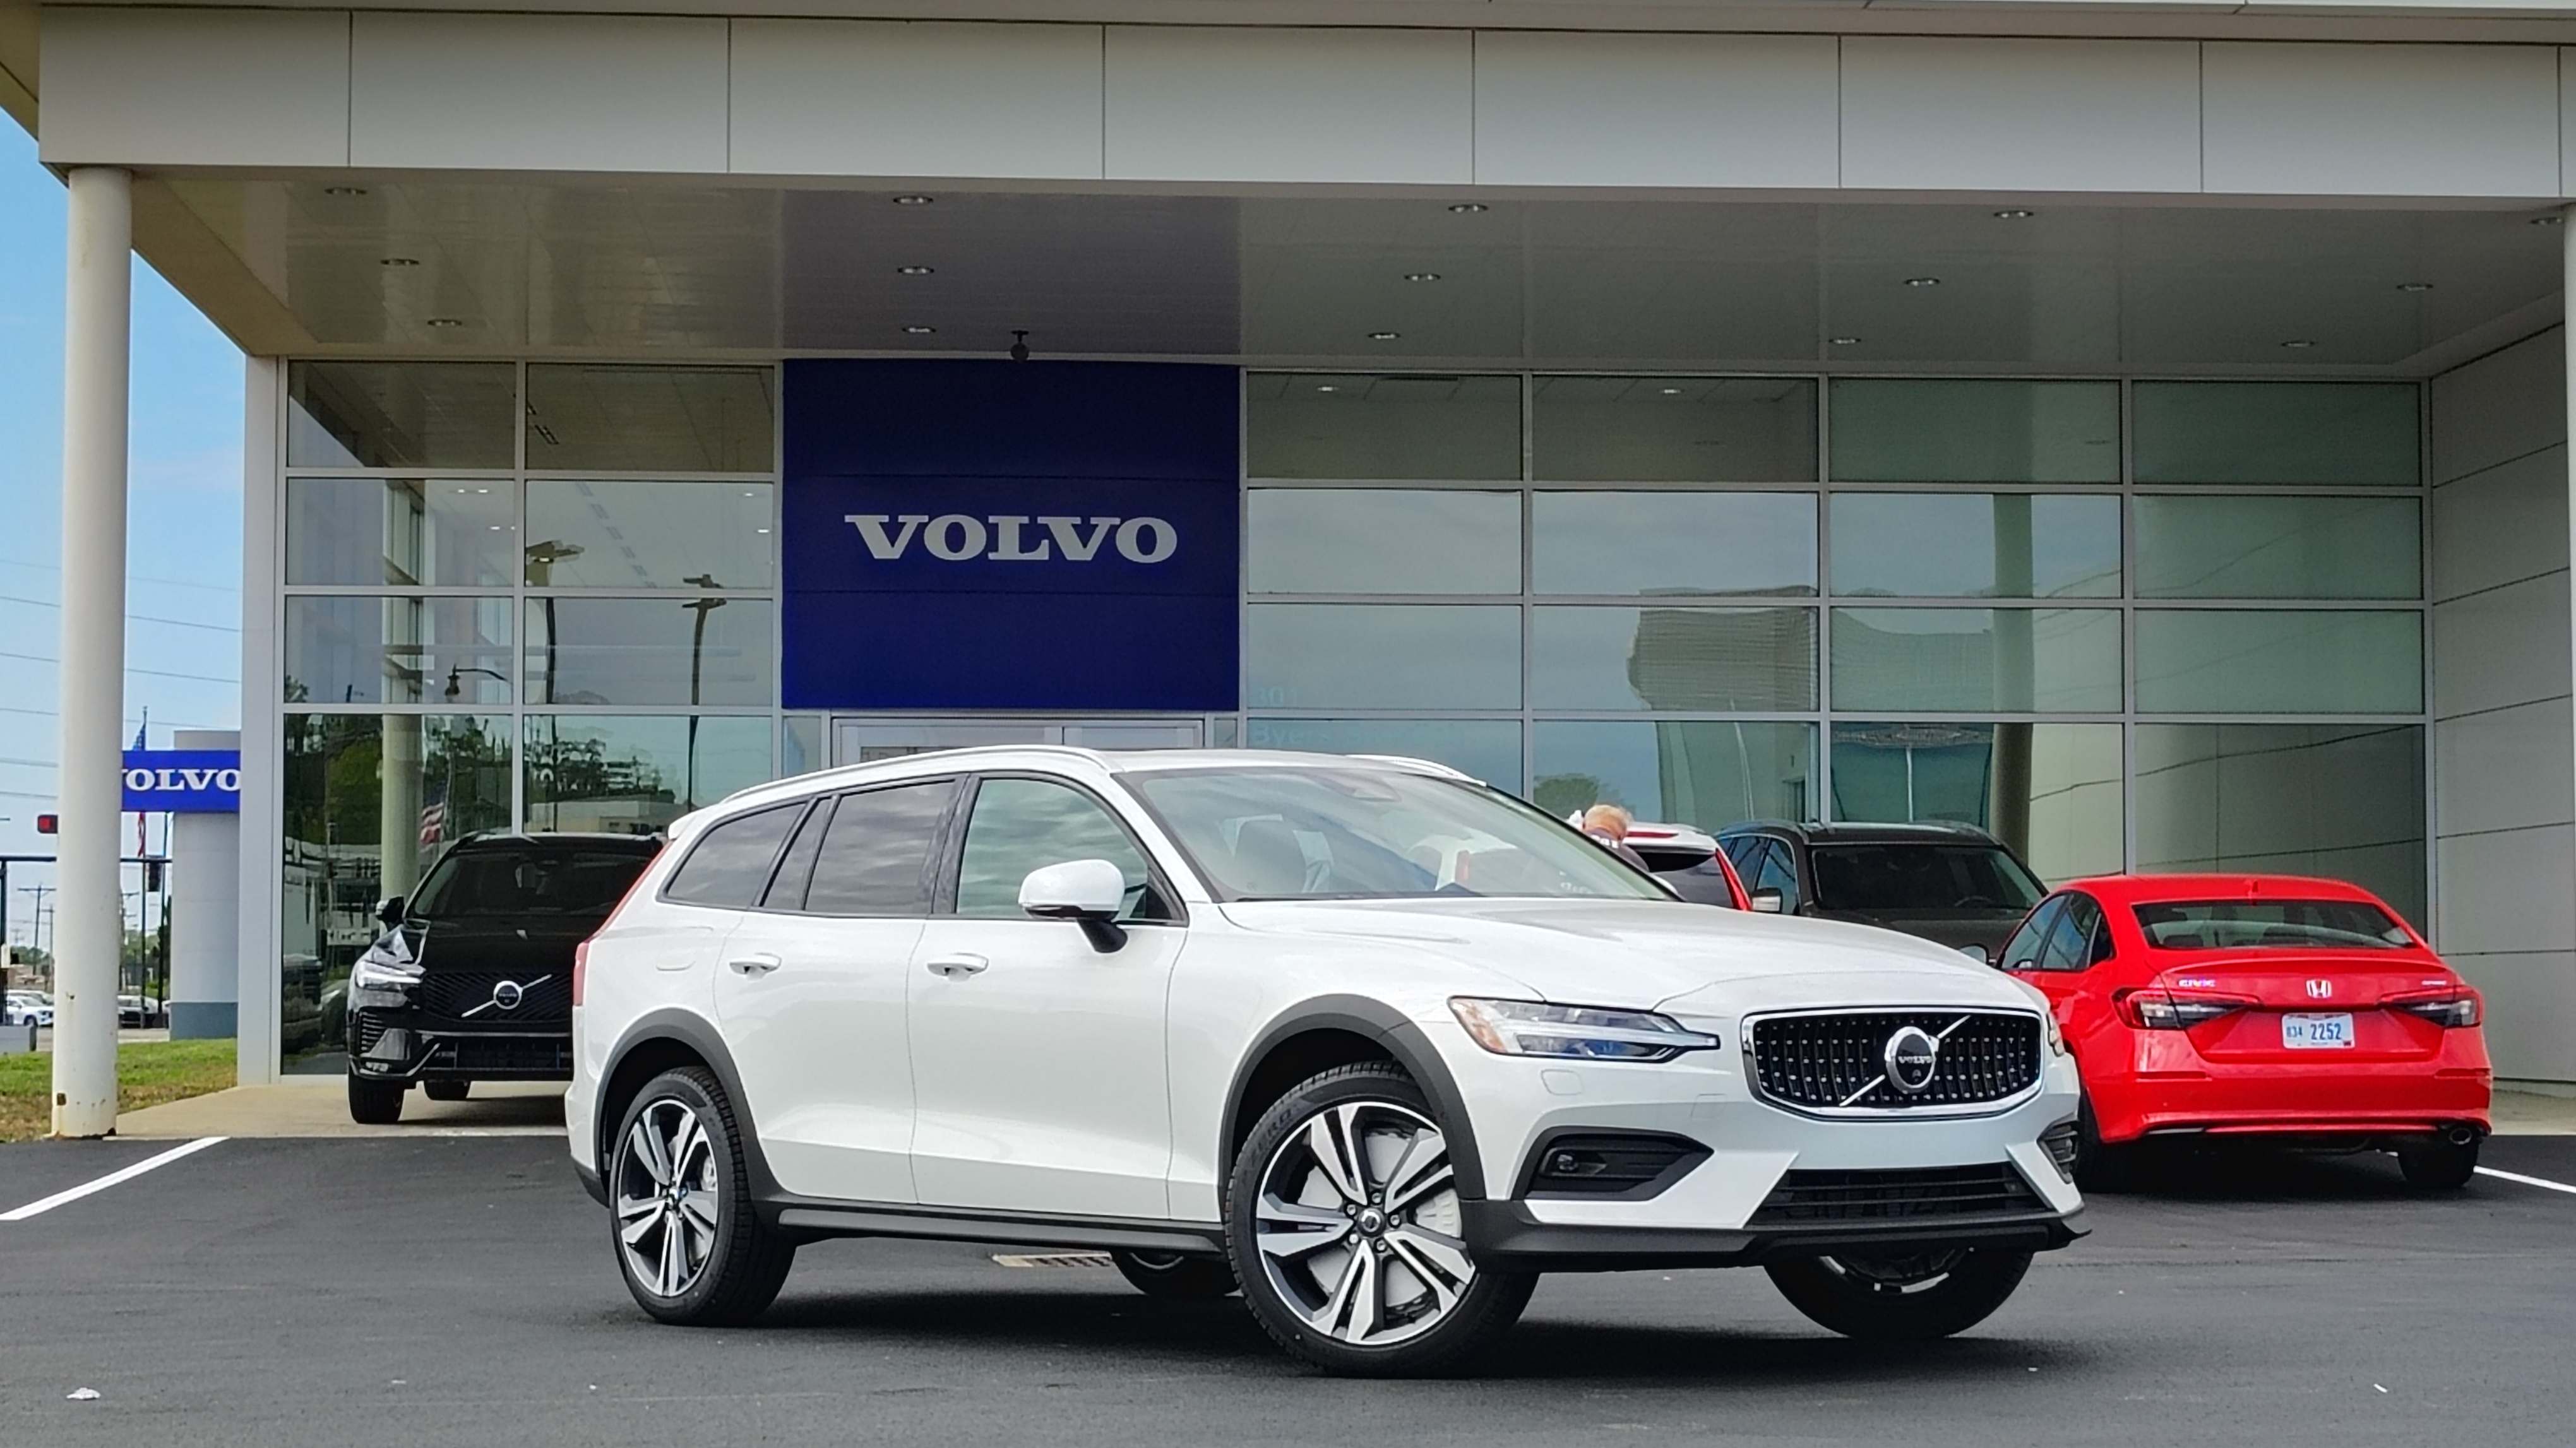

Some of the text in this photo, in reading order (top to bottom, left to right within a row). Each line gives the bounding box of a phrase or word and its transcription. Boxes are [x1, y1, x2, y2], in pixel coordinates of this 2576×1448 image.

[844, 514, 1178, 563] VOLVO
[122, 768, 241, 791] OLVO
[2310, 1023, 2342, 1040] 2252
